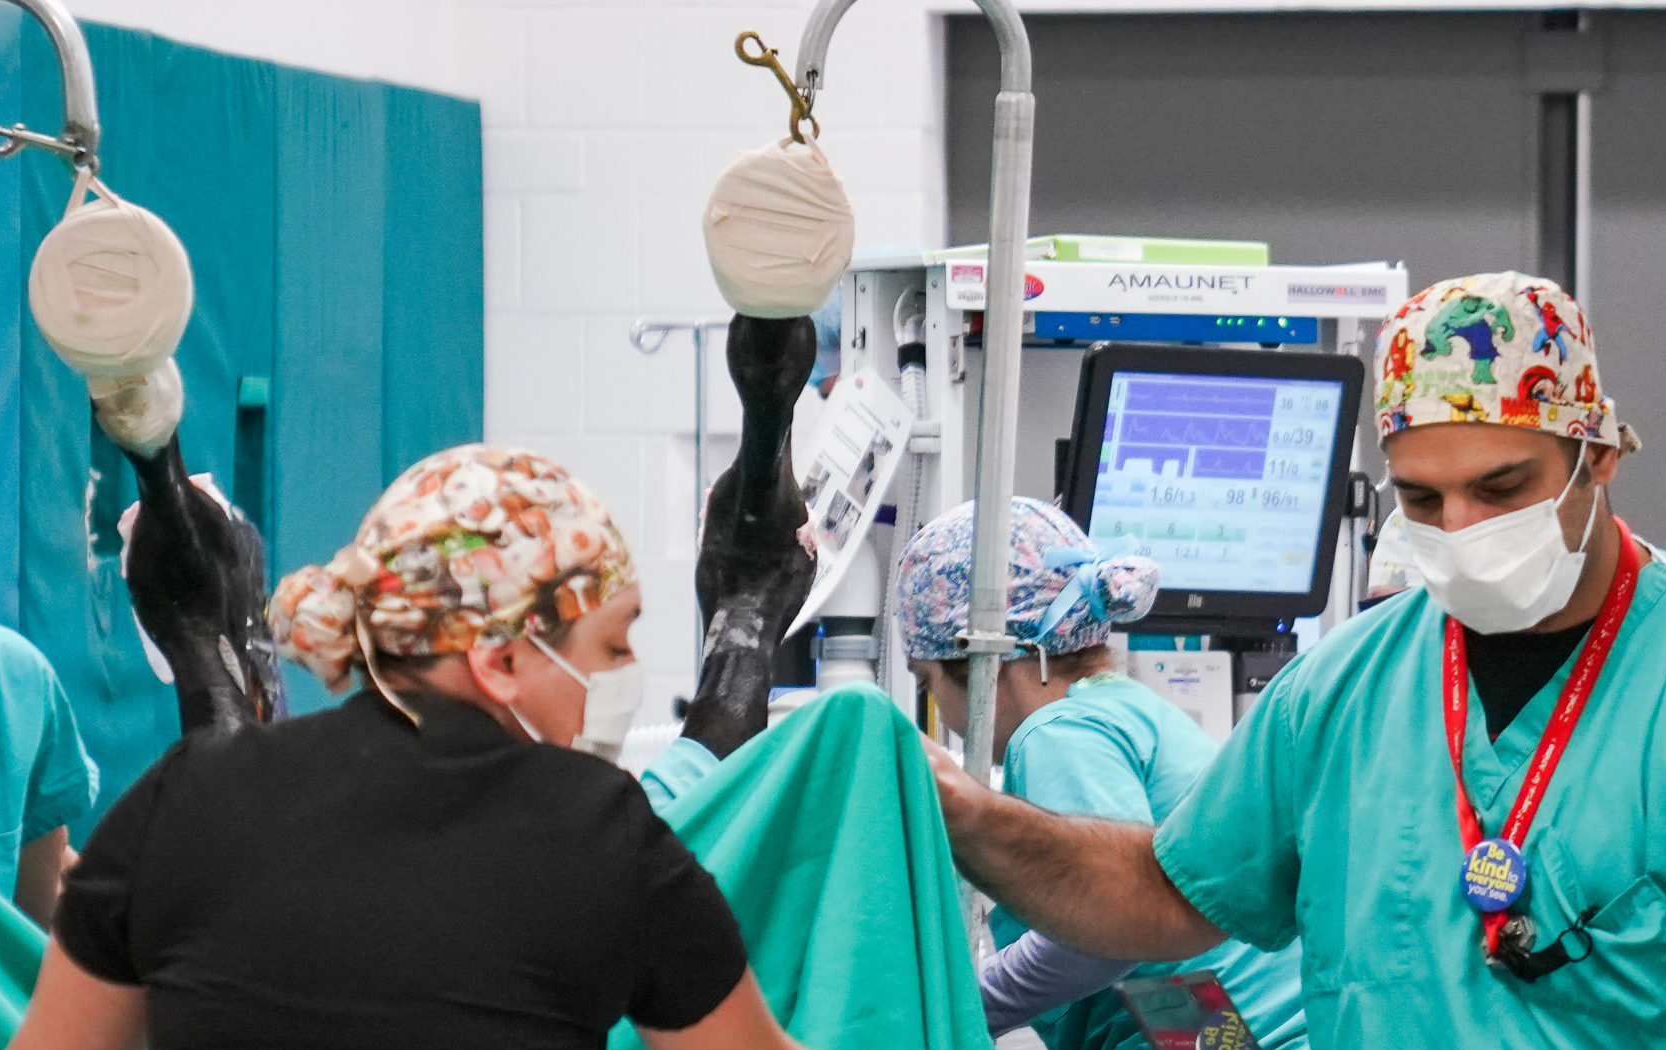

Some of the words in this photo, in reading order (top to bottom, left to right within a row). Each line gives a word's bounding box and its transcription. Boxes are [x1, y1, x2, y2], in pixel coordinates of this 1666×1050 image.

[1108, 273, 1255, 295] AMAUNET
[1288, 285, 1356, 296] HALLOWLL
[1226, 488, 1245, 505] 98
[1487, 843, 1505, 861] Be
[1468, 849, 1512, 882] kind
